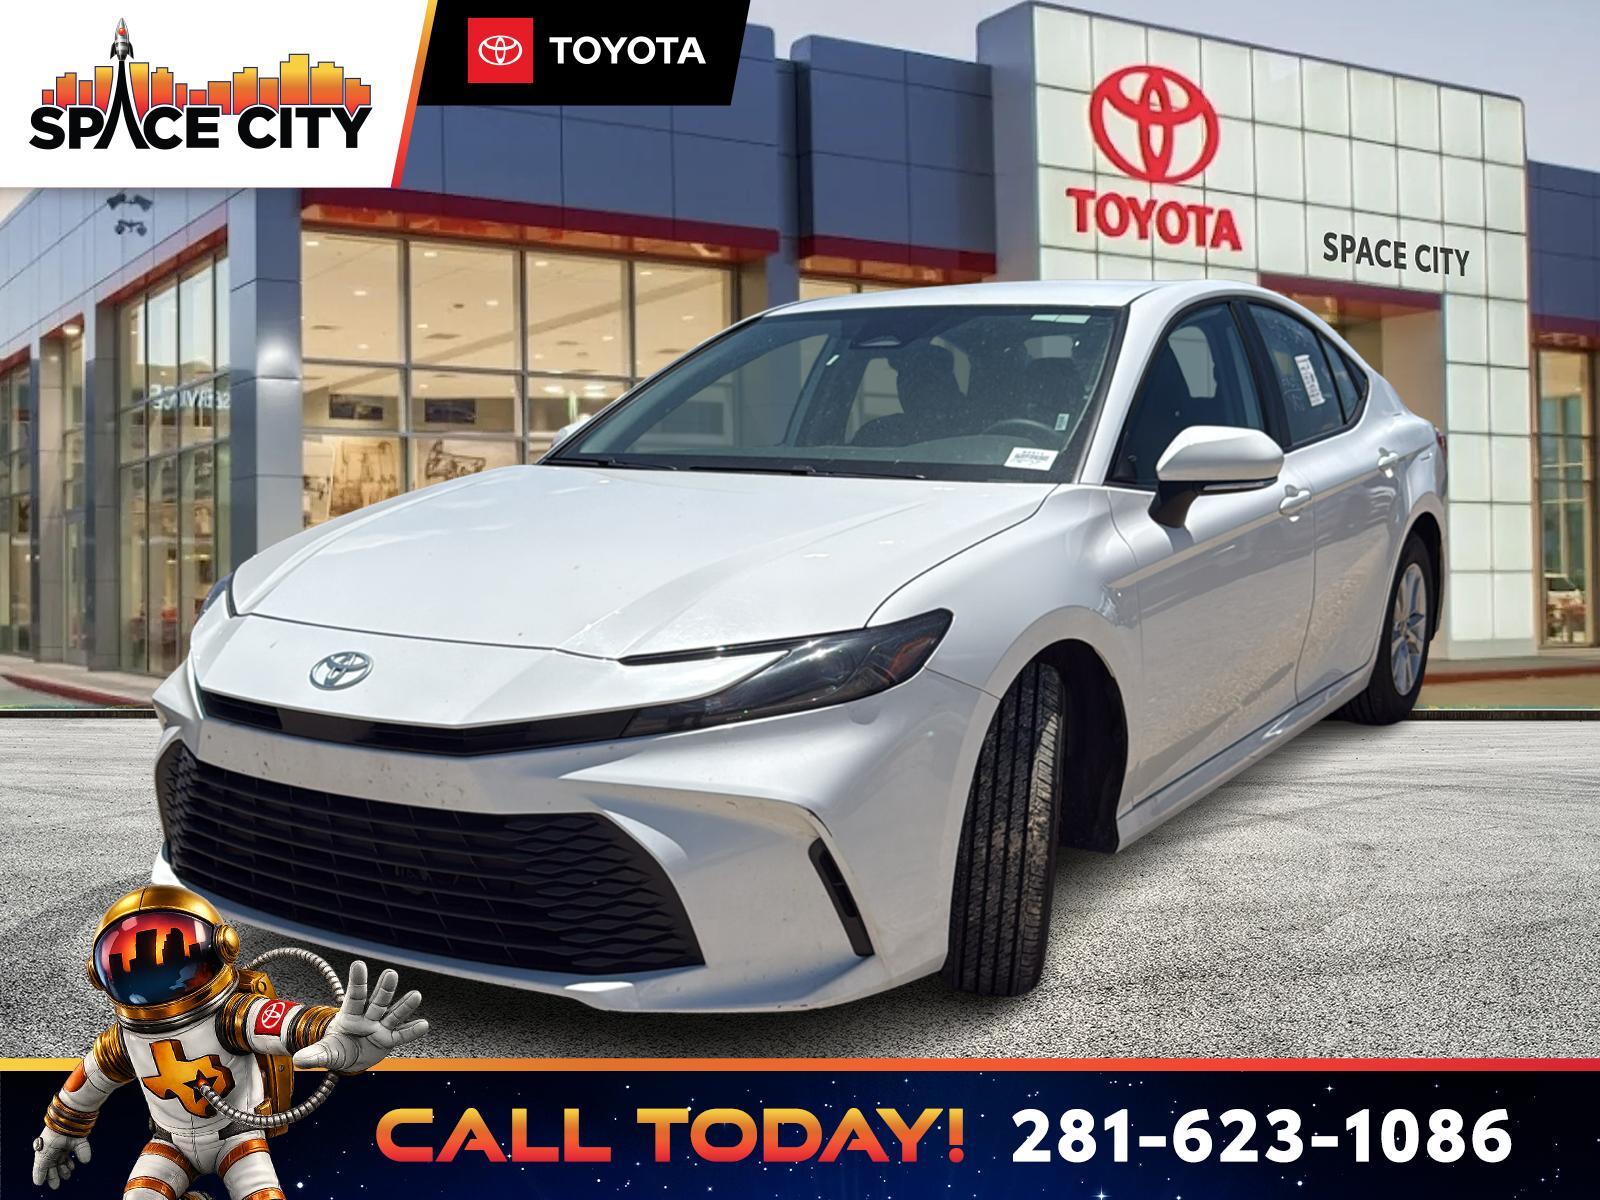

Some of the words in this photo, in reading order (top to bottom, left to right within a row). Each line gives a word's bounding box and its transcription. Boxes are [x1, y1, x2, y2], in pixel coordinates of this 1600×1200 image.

[1066, 188, 1242, 251] TOYOTA
[1323, 232, 1407, 270] SPACE
[1414, 244, 1470, 277] CITY
